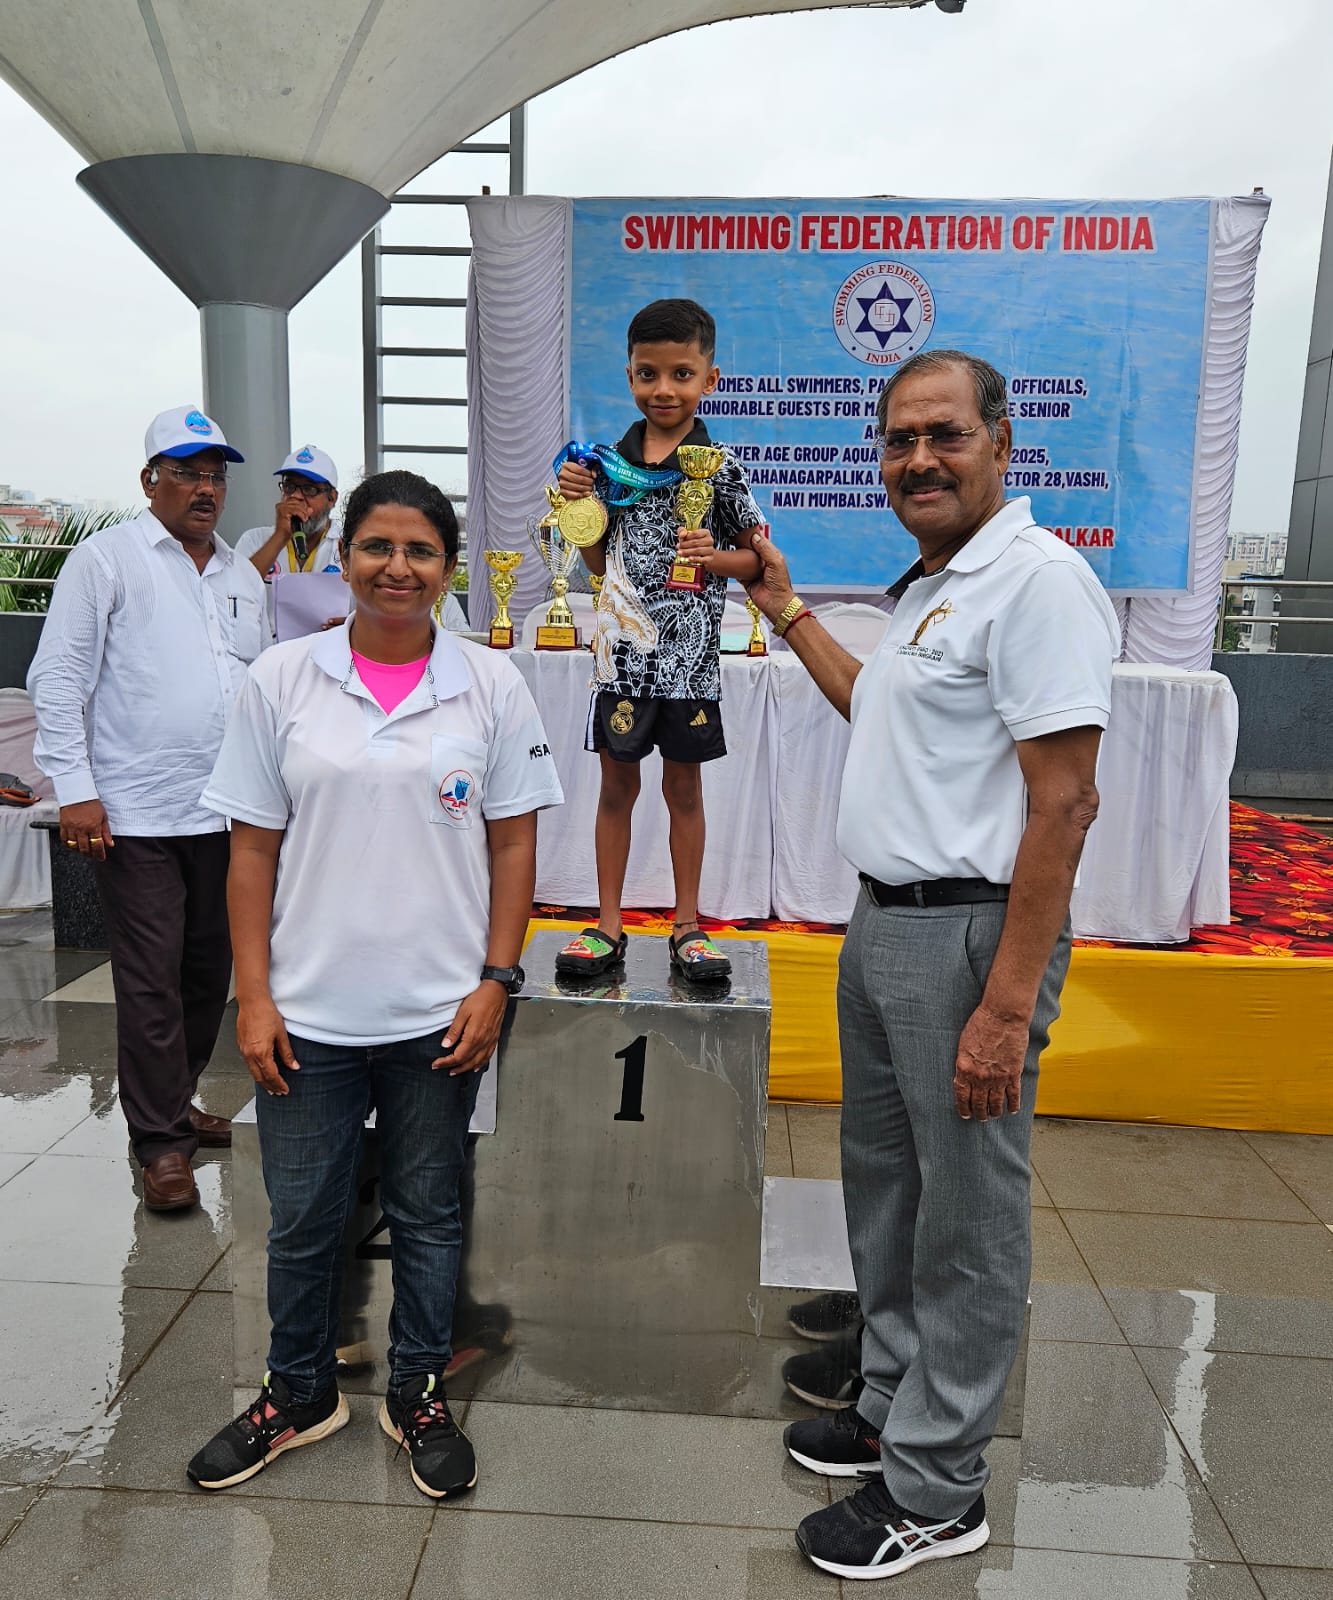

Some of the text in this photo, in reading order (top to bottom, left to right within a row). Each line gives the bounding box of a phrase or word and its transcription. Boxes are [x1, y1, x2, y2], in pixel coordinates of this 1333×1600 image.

[625, 215, 1154, 250] SWIMMING FEDERATION OF INDIA
[835, 264, 932, 327] SWIMMING FEDERATION
[866, 352, 901, 364] INDIA
[716, 377, 754, 393] OMES
[757, 377, 783, 393] ALL
[787, 377, 865, 396] SWIMMERS,
[1012, 379, 1088, 396] OFFICIALS,
[778, 401, 831, 417] GUESTS
[834, 401, 861, 417] FOR
[1020, 402, 1071, 418] SENIOR
[730, 446, 1050, 466] WER AGE GROUP AQUA 2025,
[1004, 471, 1041, 487] CTOR
[773, 492, 804, 507] NAVI
[1046, 527, 1114, 547] ALKAR
[613, 1034, 648, 1122] 1
